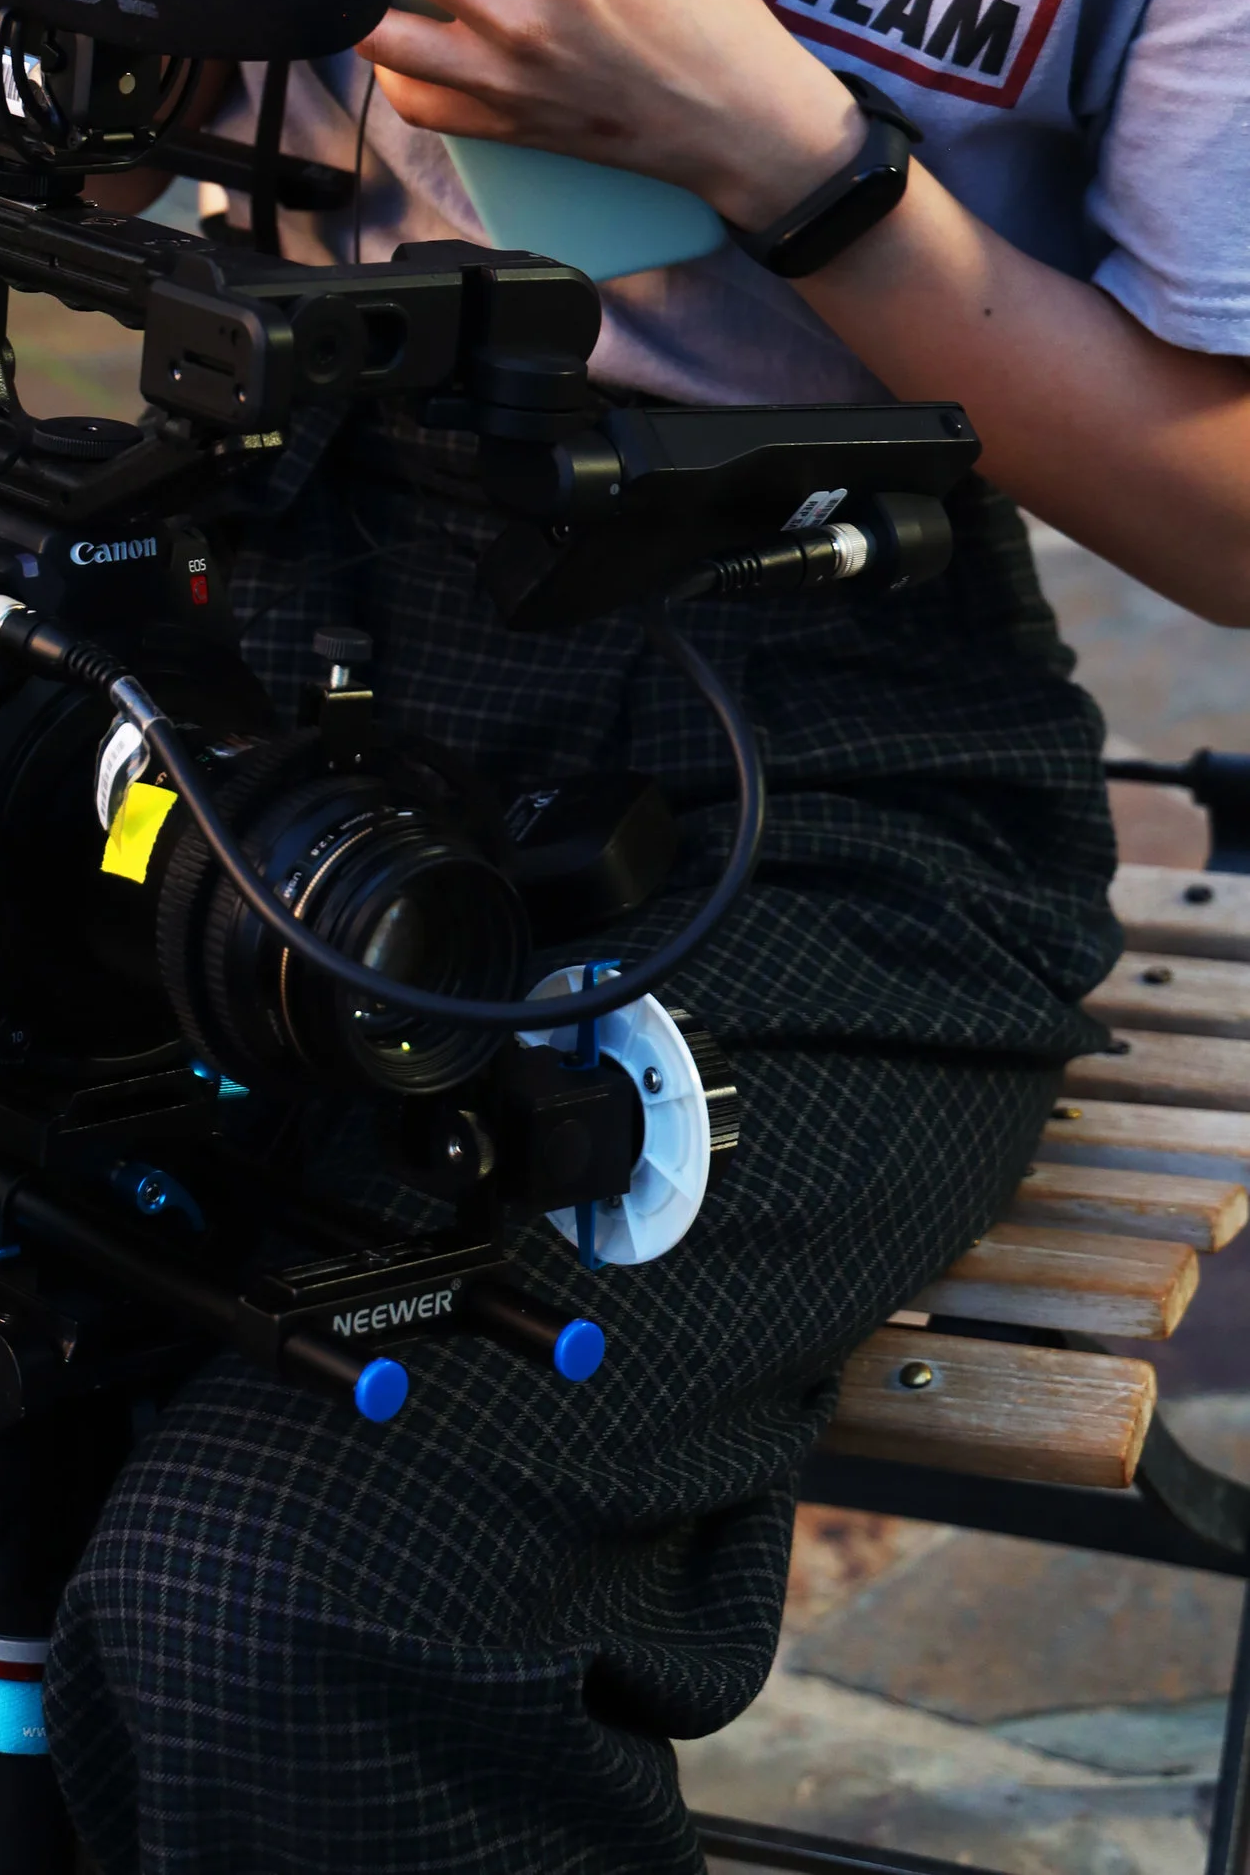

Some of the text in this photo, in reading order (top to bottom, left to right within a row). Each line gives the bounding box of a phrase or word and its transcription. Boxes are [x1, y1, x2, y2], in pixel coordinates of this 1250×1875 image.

[69, 536, 157, 566] Canon
[188, 558, 207, 573] EOS
[332, 1288, 453, 1338] NEEWER
